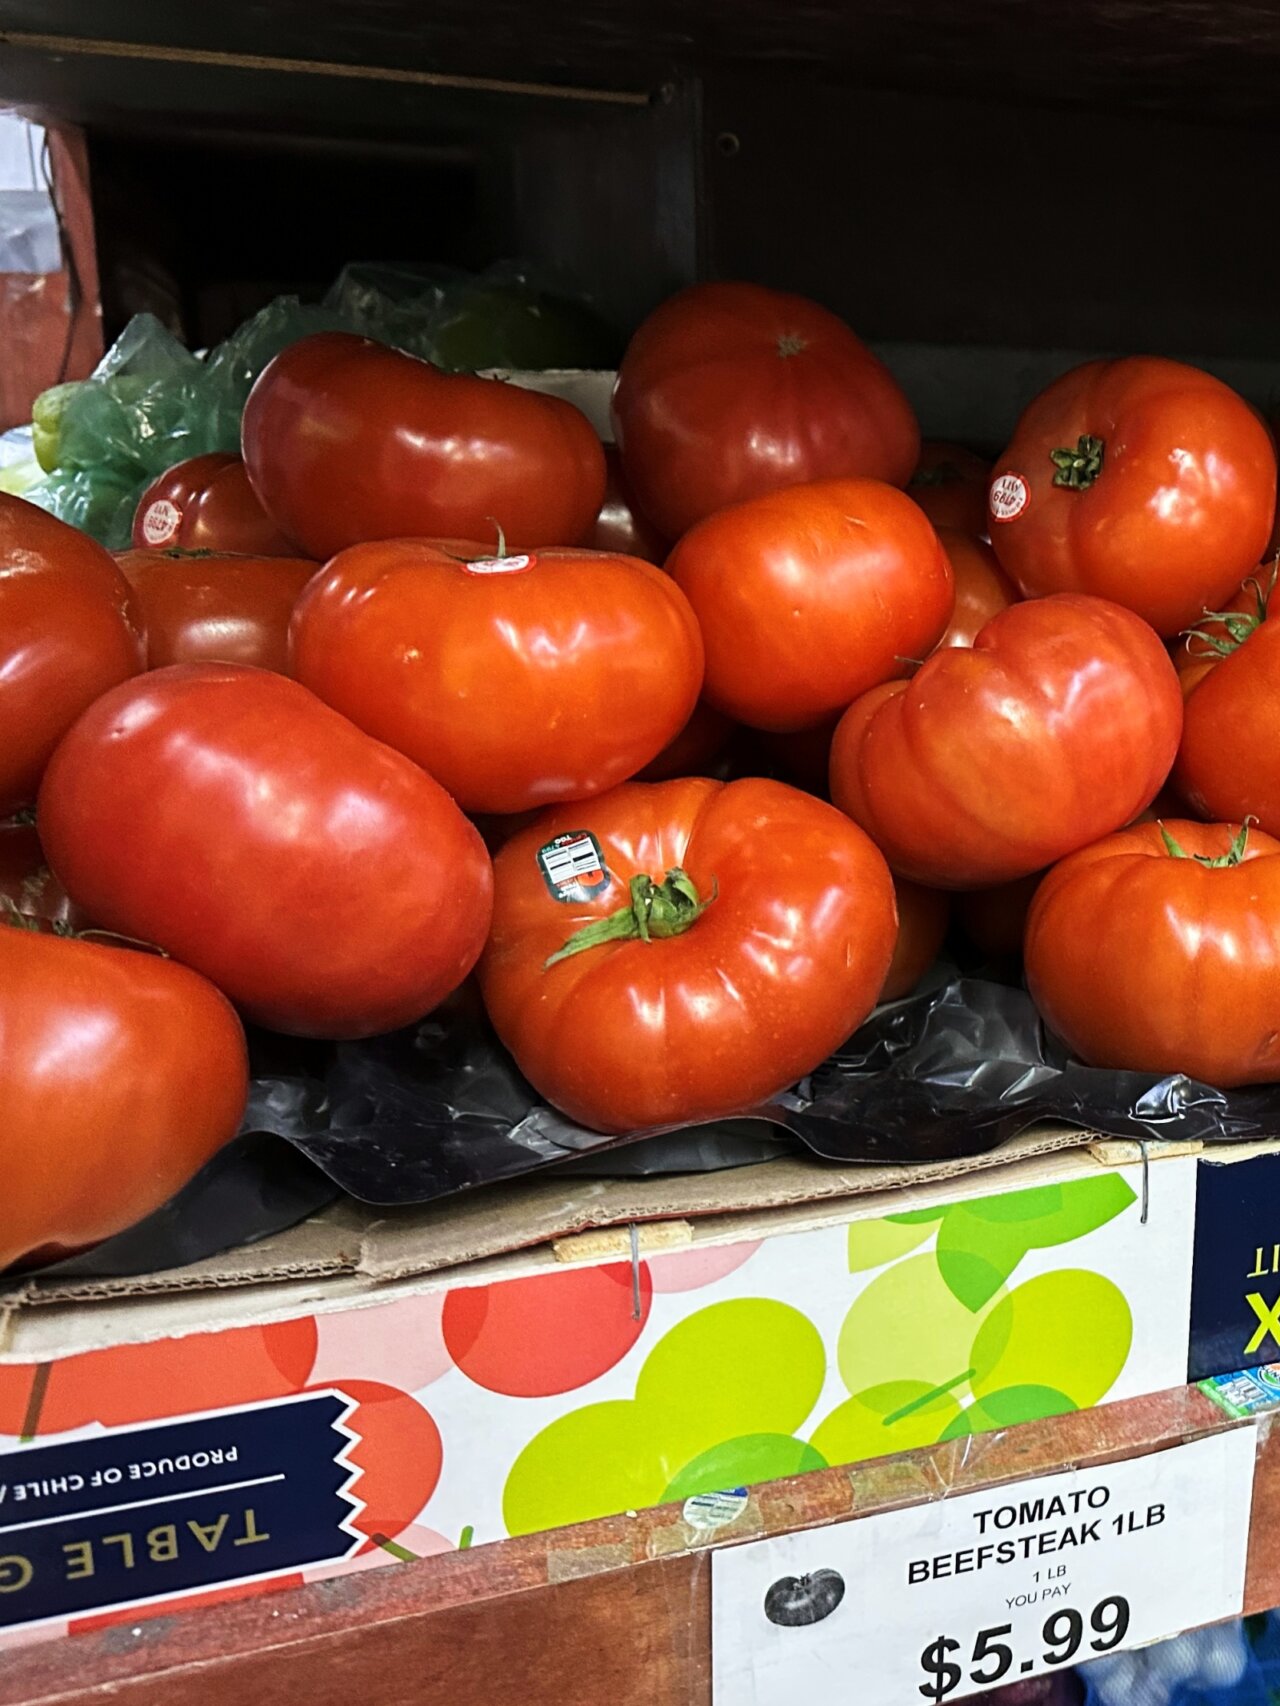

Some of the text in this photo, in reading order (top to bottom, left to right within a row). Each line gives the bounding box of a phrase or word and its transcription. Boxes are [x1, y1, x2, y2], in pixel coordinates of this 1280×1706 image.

[90, 1468, 122, 1488] OF
[129, 1446, 239, 1480] PRODUCE
[14, 1474, 85, 1501] CHILE
[973, 1485, 1111, 1534] TOMATO
[62, 1509, 270, 1580] TABLE
[908, 1503, 1166, 1585] BEEFSTEAK 1LB
[1032, 1564, 1067, 1583] 1 LB
[1005, 1582, 1072, 1610] YOU PAY
[918, 1595, 1131, 1705] $5.99
